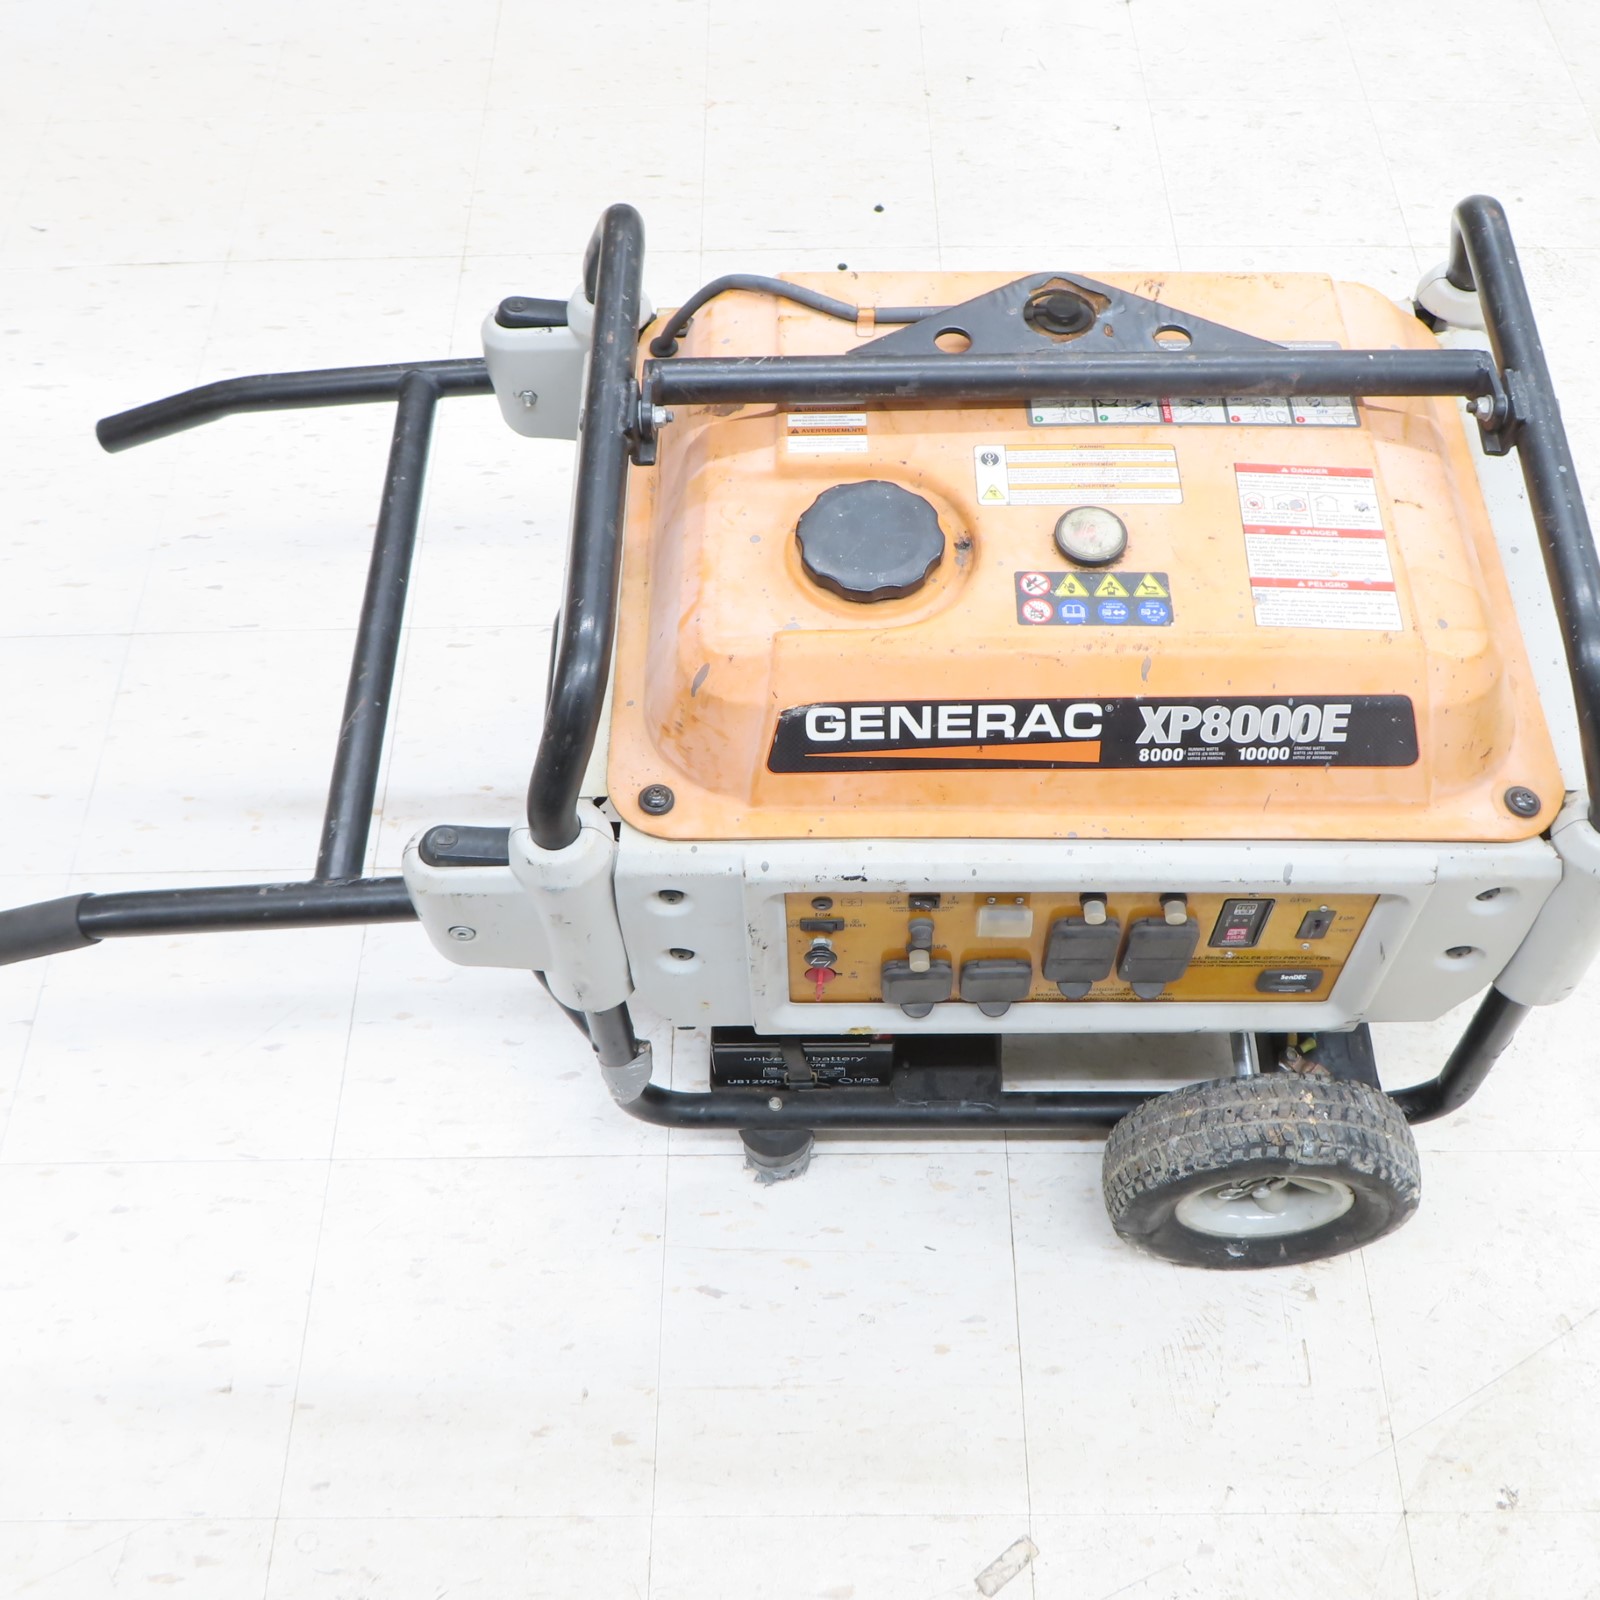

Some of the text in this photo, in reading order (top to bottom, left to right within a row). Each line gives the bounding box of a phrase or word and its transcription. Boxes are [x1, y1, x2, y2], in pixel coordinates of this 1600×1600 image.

[1290, 467, 1329, 475] DANGER
[1299, 529, 1339, 537] DANGER
[1307, 580, 1349, 589] PELIGRO
[805, 703, 1103, 742] GENERAC
[1135, 704, 1352, 744] XP8000E
[1138, 747, 1184, 762] 8000
[1238, 747, 1290, 761] 10000
[812, 1055, 865, 1063] battery
